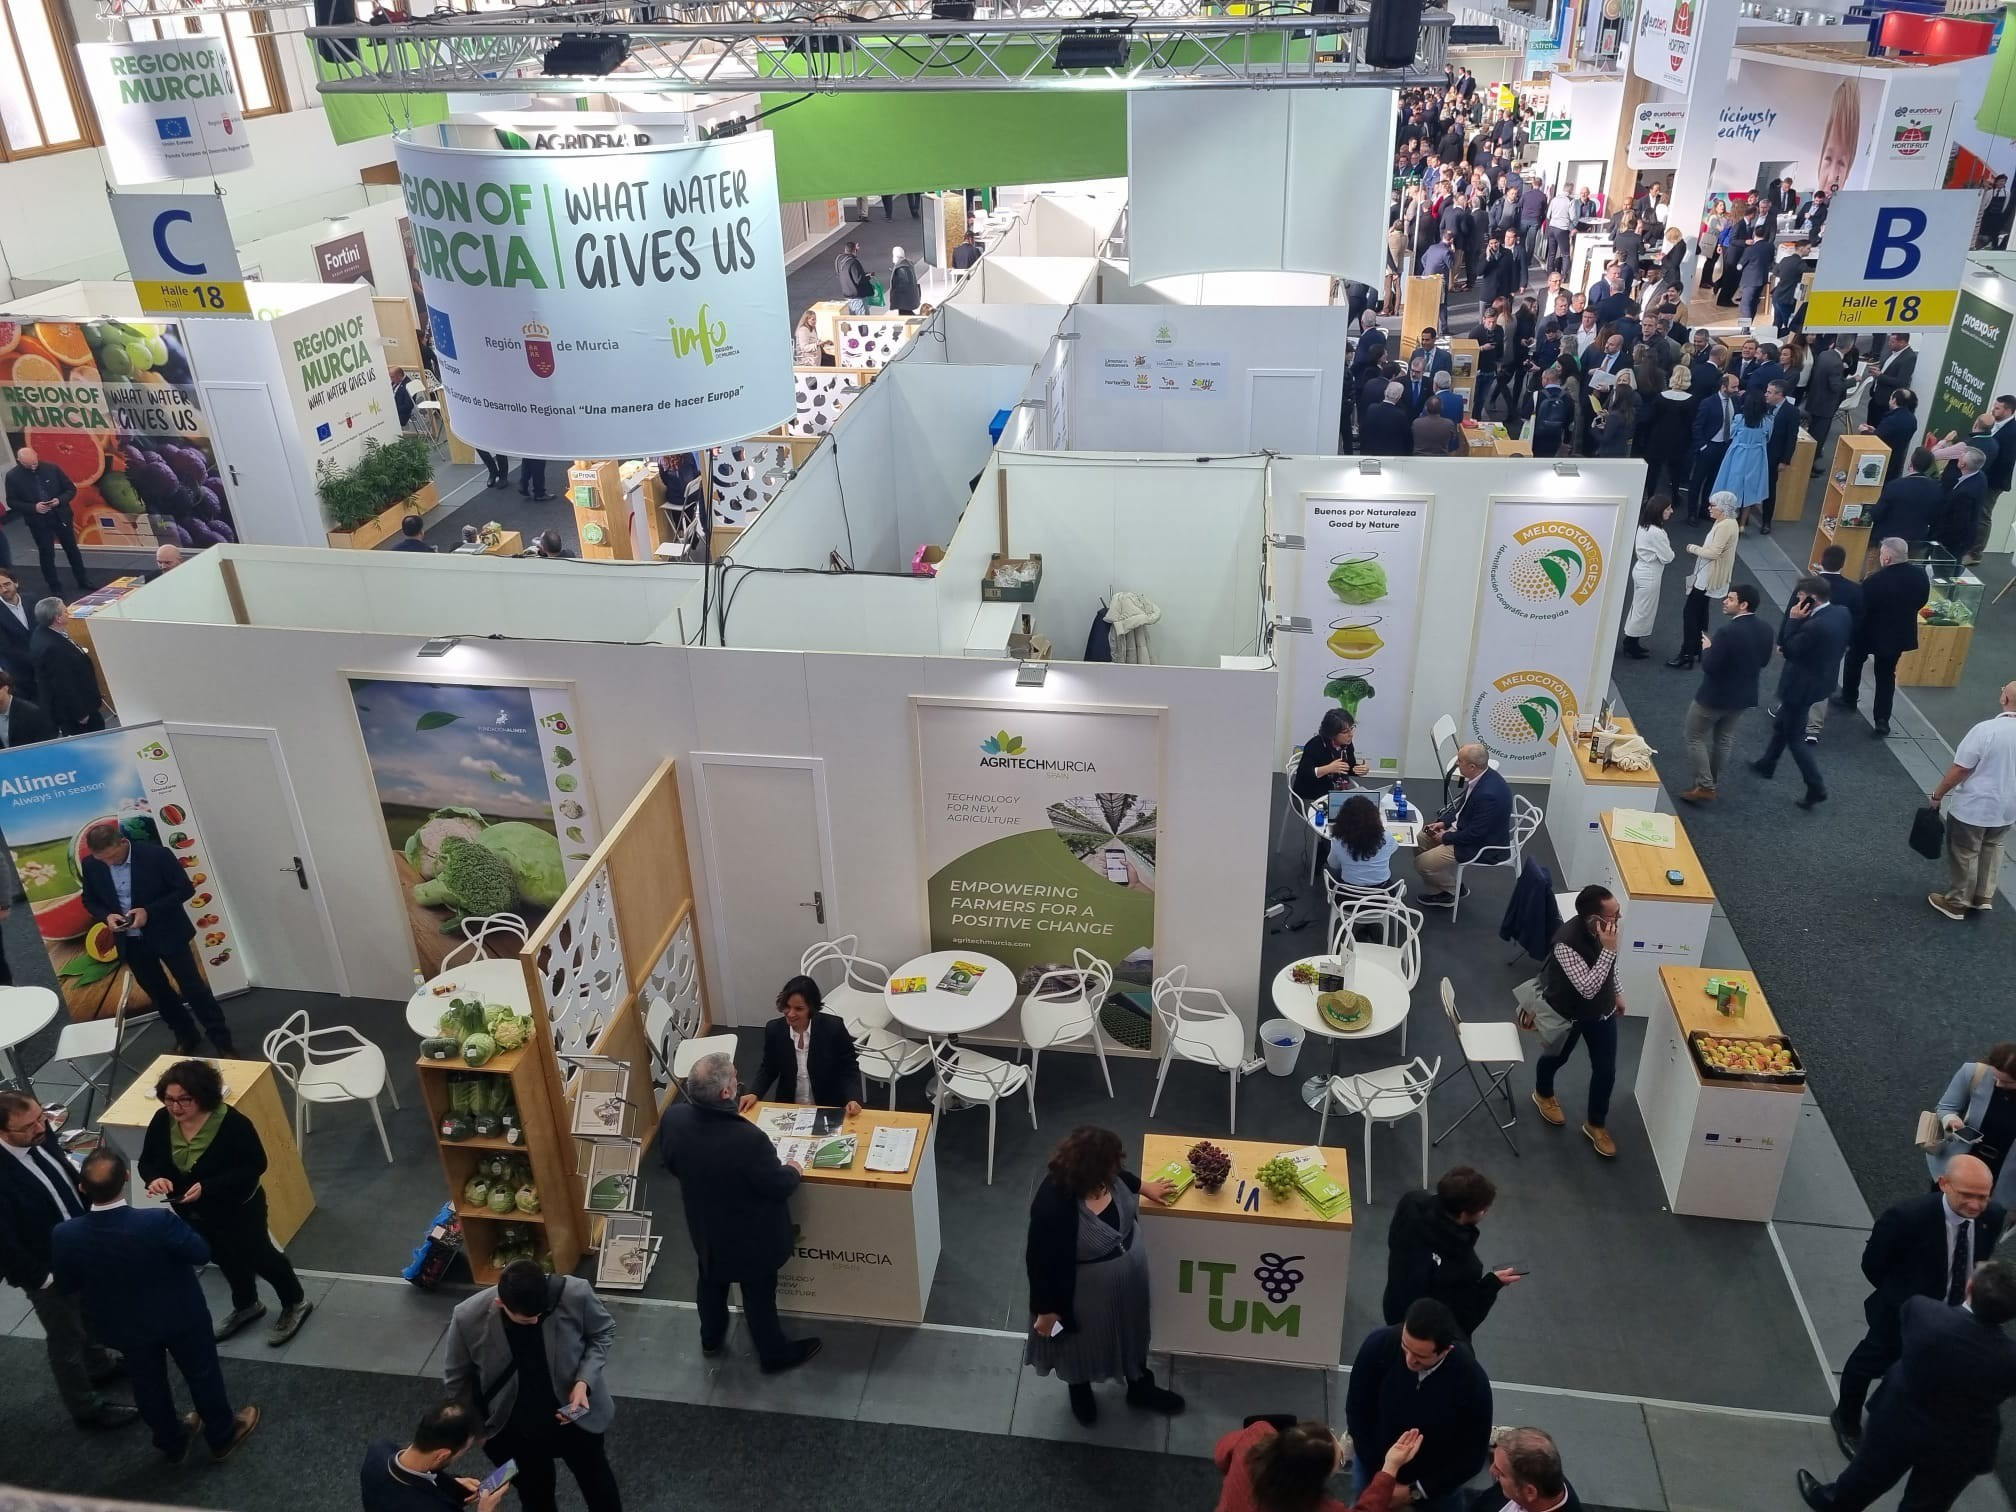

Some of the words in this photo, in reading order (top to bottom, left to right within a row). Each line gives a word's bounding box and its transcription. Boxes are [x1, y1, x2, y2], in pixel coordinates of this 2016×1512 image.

[110, 51, 195, 76] REGION
[196, 50, 215, 69] OF
[120, 73, 224, 104] MURCIA
[1720, 106, 1776, 128] liciously
[1718, 124, 1761, 143] ealthy
[401, 171, 473, 224] GION
[475, 182, 533, 226] OF
[564, 179, 650, 226] WHAT
[662, 167, 750, 221] WATER
[152, 209, 208, 276] C
[574, 225, 701, 290] GIVES
[712, 216, 756, 275] US
[1863, 206, 1928, 280] B
[324, 244, 361, 271] Fortini
[410, 221, 549, 290] URCIA
[160, 285, 189, 298] Halle
[163, 297, 183, 309] hall
[192, 286, 225, 309] 18
[1842, 295, 1878, 309] Halle
[1838, 308, 1863, 322] hall
[1883, 295, 1921, 323] 18
[293, 322, 347, 362] REGION
[346, 315, 364, 338] OF
[668, 303, 727, 367] info
[1961, 313, 2000, 342] proexport
[485, 336, 522, 352] Región
[556, 340, 572, 351] de
[576, 339, 620, 351] Murcia
[301, 340, 373, 393] MURCIA
[1950, 360, 1963, 377] The
[1961, 368, 1986, 391] flavour
[2, 385, 75, 404] REGION
[75, 386, 100, 404] OF
[110, 387, 143, 405] WHAT
[147, 388, 191, 407] WATER
[308, 390, 326, 411] WHAT
[326, 381, 348, 402] WATER
[367, 367, 377, 383] US
[1944, 375, 1953, 386] of
[1951, 378, 1963, 392] the
[1961, 383, 1982, 406] future
[11, 406, 110, 429] MURCIA
[472, 396, 482, 407] de
[483, 398, 528, 414] Desarrollo
[530, 403, 576, 416] Regional
[611, 403, 654, 414] manera
[657, 400, 671, 410] de
[674, 395, 705, 408] hacer
[118, 407, 169, 431] GIVES
[172, 408, 198, 432] US
[1314, 507, 1347, 515] Buenos
[1366, 508, 1417, 517] Naturaleza
[1328, 520, 1354, 528] Good
[1355, 520, 1367, 529] by
[1368, 520, 1400, 529] Nature
[1490, 544, 1508, 593] Identificación
[1522, 524, 1593, 553] MELOCOTÓN
[1579, 562, 1599, 596] CIEZA
[1496, 592, 1529, 619] Geográfica
[1529, 609, 1569, 620] Protegida
[1502, 674, 1569, 698] MELOCOTÓN
[1471, 690, 1488, 737] Identificación
[1509, 750, 1547, 761] Protegida
[980, 756, 1097, 773] AGRITECHMURCIA
[1, 769, 77, 797] Alimer
[12, 793, 54, 808] Always
[56, 788, 66, 798] in
[67, 782, 106, 796] season
[946, 792, 1021, 804] TECHNOLOGY
[946, 803, 969, 812] FOR
[971, 804, 999, 814] NEW
[946, 814, 1023, 825] AGRICULTURE
[950, 879, 1079, 899] EMPOWERING
[951, 897, 1036, 913] FARMERS
[1039, 902, 1078, 917] FOR
[1080, 905, 1095, 917] A
[951, 914, 1032, 930] POSITIVE
[1036, 919, 1115, 936] CHANGE
[952, 936, 1031, 948] agritechmurcia.com
[792, 1247, 893, 1266] TECHMURCIA
[1178, 1259, 1237, 1297] IT
[1208, 1297, 1302, 1338] UM
